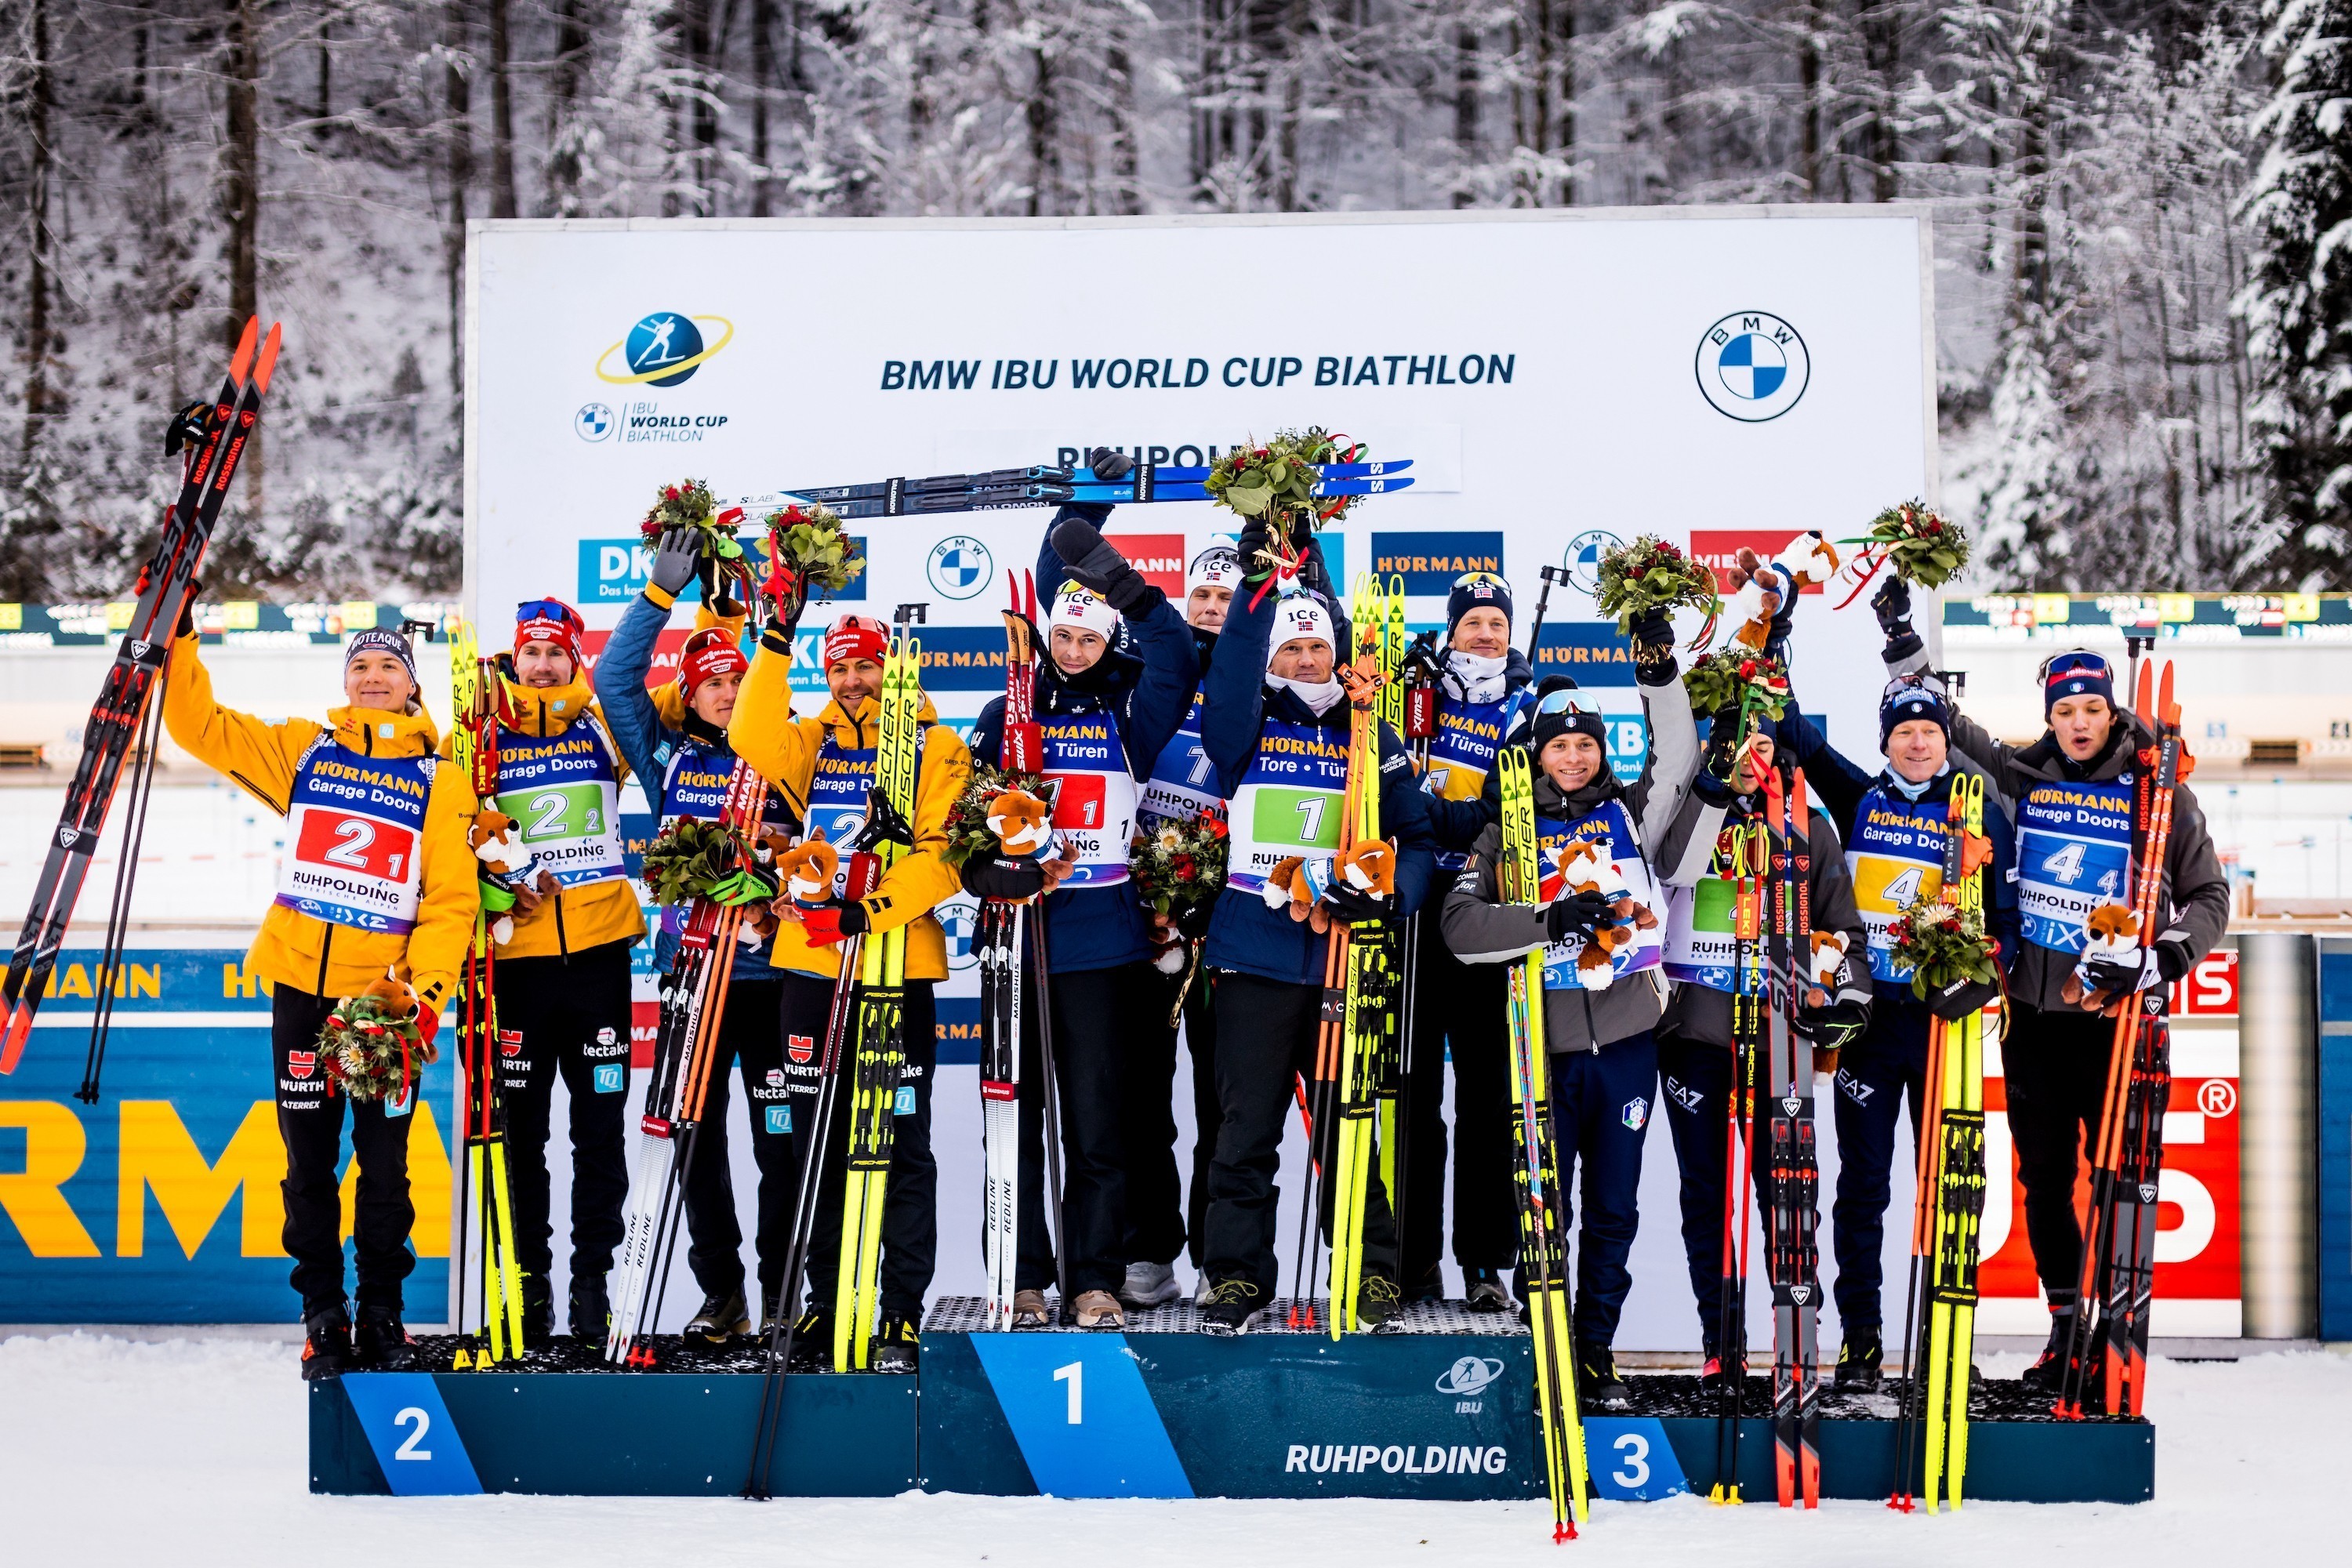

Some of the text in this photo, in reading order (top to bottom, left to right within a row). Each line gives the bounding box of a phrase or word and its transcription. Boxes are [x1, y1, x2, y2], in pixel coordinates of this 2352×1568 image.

[1711, 317, 1793, 346] BMW
[880, 354, 1515, 390] BMW IBU WORLD CUP BIATHLON
[630, 416, 728, 427] WORLD CUP
[633, 402, 657, 414] IBU
[627, 430, 703, 442] BIATHLON
[889, 479, 898, 514] SALOMON
[1138, 465, 1148, 501] SALOMON
[972, 501, 1050, 512] SALOMON
[938, 539, 983, 556] BMW
[599, 546, 652, 579] DK
[1378, 555, 1498, 572] HÖRMANN
[599, 585, 621, 597] Das
[1120, 623, 1129, 648] SKO
[919, 650, 1009, 667] ÖRMAN
[1539, 646, 1630, 663] HÖRMA
[1389, 631, 1402, 728] ISCHER
[1413, 692, 1425, 732] swix
[1040, 725, 1107, 739] RMANN
[1439, 714, 1501, 741] RMANN
[896, 698, 914, 822] FISCHER
[1014, 728, 1025, 773] swix
[1055, 742, 1108, 759] Türen
[1450, 733, 1494, 760] Türen
[499, 759, 597, 780] arage Doors
[816, 757, 877, 775] HÖRMA
[1187, 746, 1212, 786] 1
[1259, 757, 1297, 773] Tore
[1613, 760, 1643, 773] Bank
[313, 760, 424, 800] HÖRMANN
[678, 770, 731, 788] HÖRM
[813, 776, 855, 794] Garage
[309, 778, 420, 815] Garage Doors
[676, 789, 726, 806] Garage
[2030, 788, 2130, 814] HÖRMANN
[527, 792, 599, 838] 2 2
[1083, 800, 1098, 825] 1
[1295, 797, 1327, 842] 1
[2027, 804, 2129, 831] Garage Doors
[1121, 818, 1129, 840] 1
[1863, 826, 1912, 845] Garage
[325, 819, 404, 877] 2 1
[532, 844, 604, 861] POLDING
[1523, 806, 1535, 903] SCHER
[1457, 871, 1479, 881] CONERI
[2042, 842, 2118, 892] 4 4
[292, 884, 398, 911] BAYERISCHE ALPEN
[294, 871, 400, 904] RUHPOLDING
[1882, 867, 1925, 910] 4
[1743, 897, 1751, 935] LEKI
[1348, 954, 1357, 1036] FISCHER
[684, 1007, 699, 1062] MADSHUS
[583, 1043, 629, 1058] tectake
[280, 1078, 325, 1092] WÜRTH
[504, 1079, 527, 1088] RREX
[598, 1068, 619, 1089] TQ
[1667, 1075, 1704, 1107] EA7
[1837, 1067, 1875, 1102] EA7
[287, 1100, 321, 1110] TERREX
[753, 1087, 789, 1099] tecta
[624, 1211, 637, 1267] REDLINE
[638, 1212, 652, 1269] REDLINE
[1053, 1361, 1082, 1425] 1
[1455, 1402, 1483, 1414] IBU
[394, 1407, 432, 1461] 2
[1285, 1445, 1507, 1475] RUHPOLDING
[1612, 1433, 1650, 1488] 3
